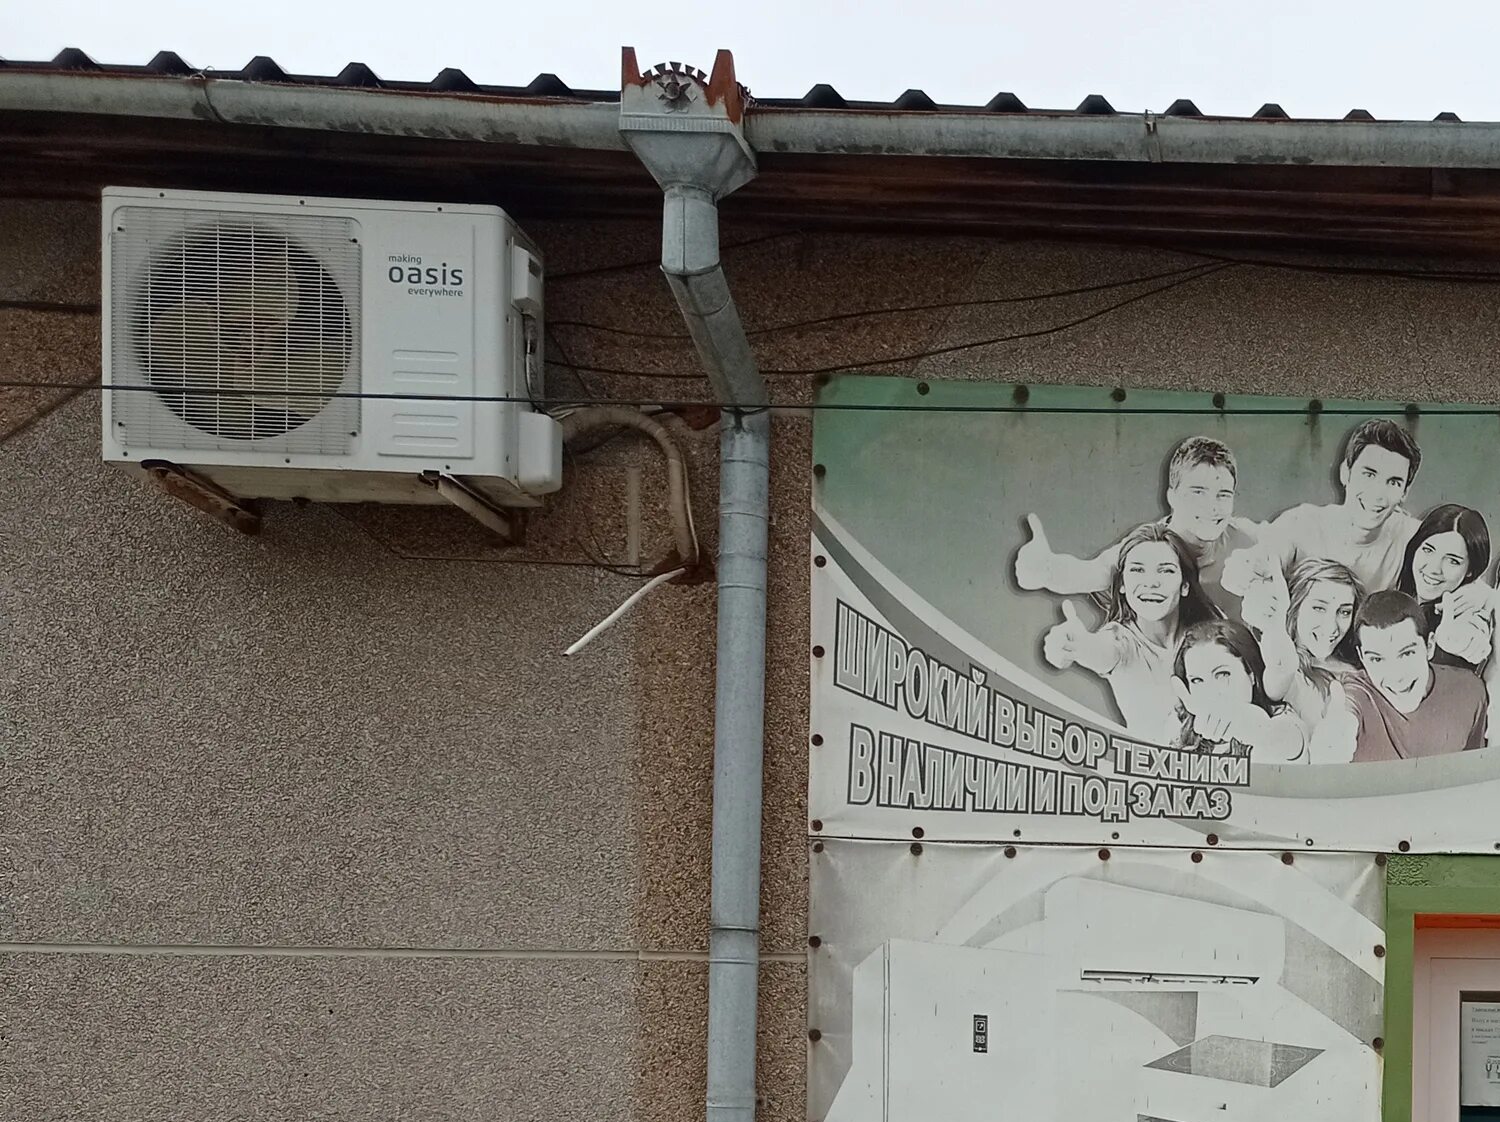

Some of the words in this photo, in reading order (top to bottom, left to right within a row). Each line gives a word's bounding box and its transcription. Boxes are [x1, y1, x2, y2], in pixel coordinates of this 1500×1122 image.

[388, 254, 422, 265] making
[388, 262, 463, 286] oasis
[407, 287, 463, 297] everywhere
[833, 598, 992, 744] ШИРОКИЙ
[993, 693, 1107, 769] ВЫБОР
[1109, 735, 1253, 787] ТЕХНИКИ
[848, 723, 877, 806] В
[877, 731, 1030, 814] НАЛИЧИИ
[1033, 767, 1058, 816] И
[1061, 771, 1130, 822] ПОД
[1130, 785, 1233, 820] ЗАКАЗ
